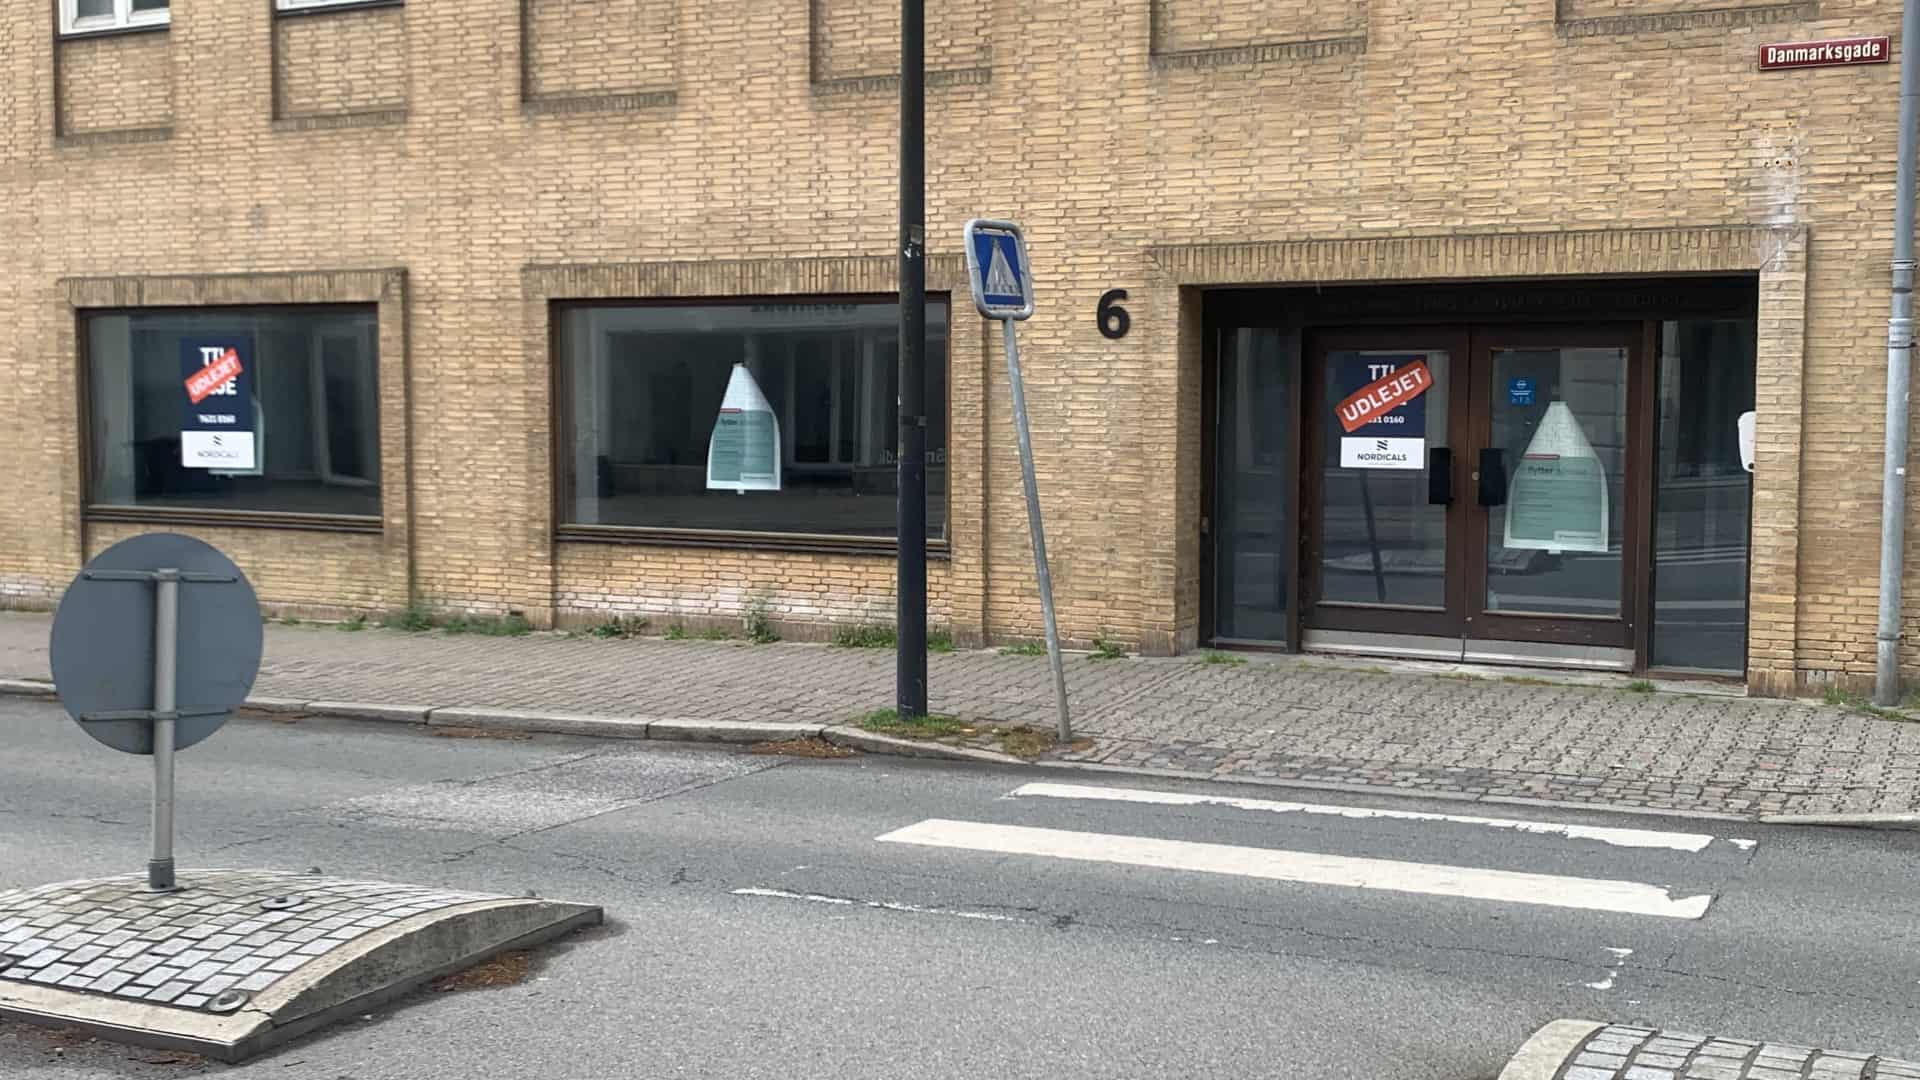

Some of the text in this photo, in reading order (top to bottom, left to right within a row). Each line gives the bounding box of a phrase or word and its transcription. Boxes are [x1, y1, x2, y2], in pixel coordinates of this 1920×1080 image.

[1767, 41, 1880, 63] Danmarksgade
[1097, 288, 1131, 340] 6
[1343, 367, 1424, 422] UDLEJET
[1357, 453, 1407, 461] NORDICALS
